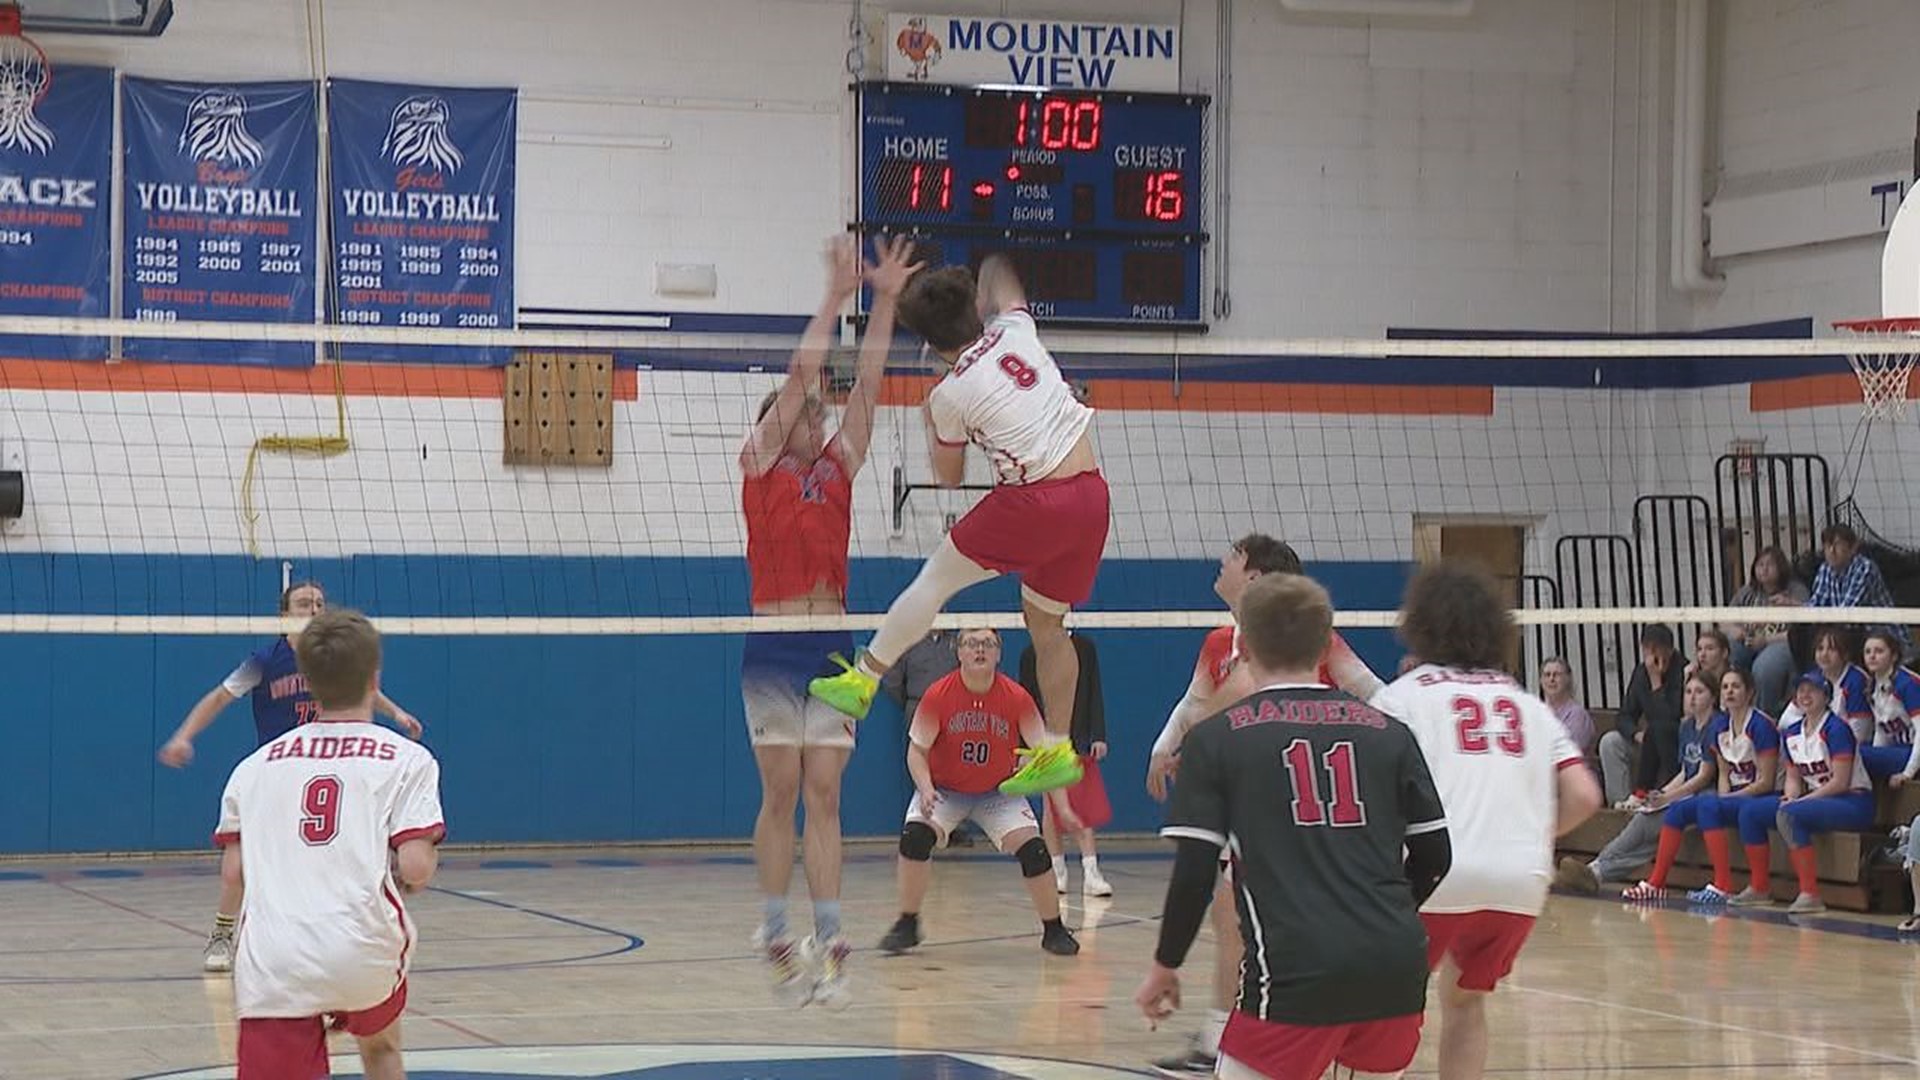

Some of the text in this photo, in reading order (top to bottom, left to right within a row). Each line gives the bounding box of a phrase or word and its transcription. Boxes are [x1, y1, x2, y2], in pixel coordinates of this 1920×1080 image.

[949, 19, 1173, 58] MOUNTAIN
[1008, 54, 1116, 87] VIEW
[1016, 100, 1102, 150] 1:00
[884, 136, 949, 160] HOME
[1012, 150, 1056, 165] PERIOD
[1114, 145, 1187, 168] GUEST
[911, 164, 952, 209] 11
[1144, 172, 1183, 220] 16
[137, 182, 302, 217] VOLLEYBALL
[343, 189, 500, 221] VOLLEYBALL
[147, 215, 289, 236] LEAGUE CHAMPIONS
[1012, 206, 1055, 221] BONUS
[353, 222, 490, 241] LEAGUE CHAMPIONS
[135, 270, 178, 284] 2005
[198, 257, 241, 271] 2000
[260, 259, 302, 274] 2001
[459, 263, 499, 276] 2000
[340, 275, 383, 289] 2001
[142, 287, 293, 309] DISTRICT CHAMPIONS
[347, 289, 491, 307] DISTRICT CHAMPIONS
[1030, 302, 1055, 316] TCH
[459, 313, 498, 327] 2000
[1132, 304, 1175, 319] POINTS
[996, 353, 1039, 390] 8
[1226, 699, 1388, 731] RAIDERS
[1450, 694, 1525, 758] 23
[266, 737, 397, 761] RAIDERS
[961, 741, 990, 767] 20
[1282, 738, 1367, 827] 11
[299, 774, 344, 846] 9
